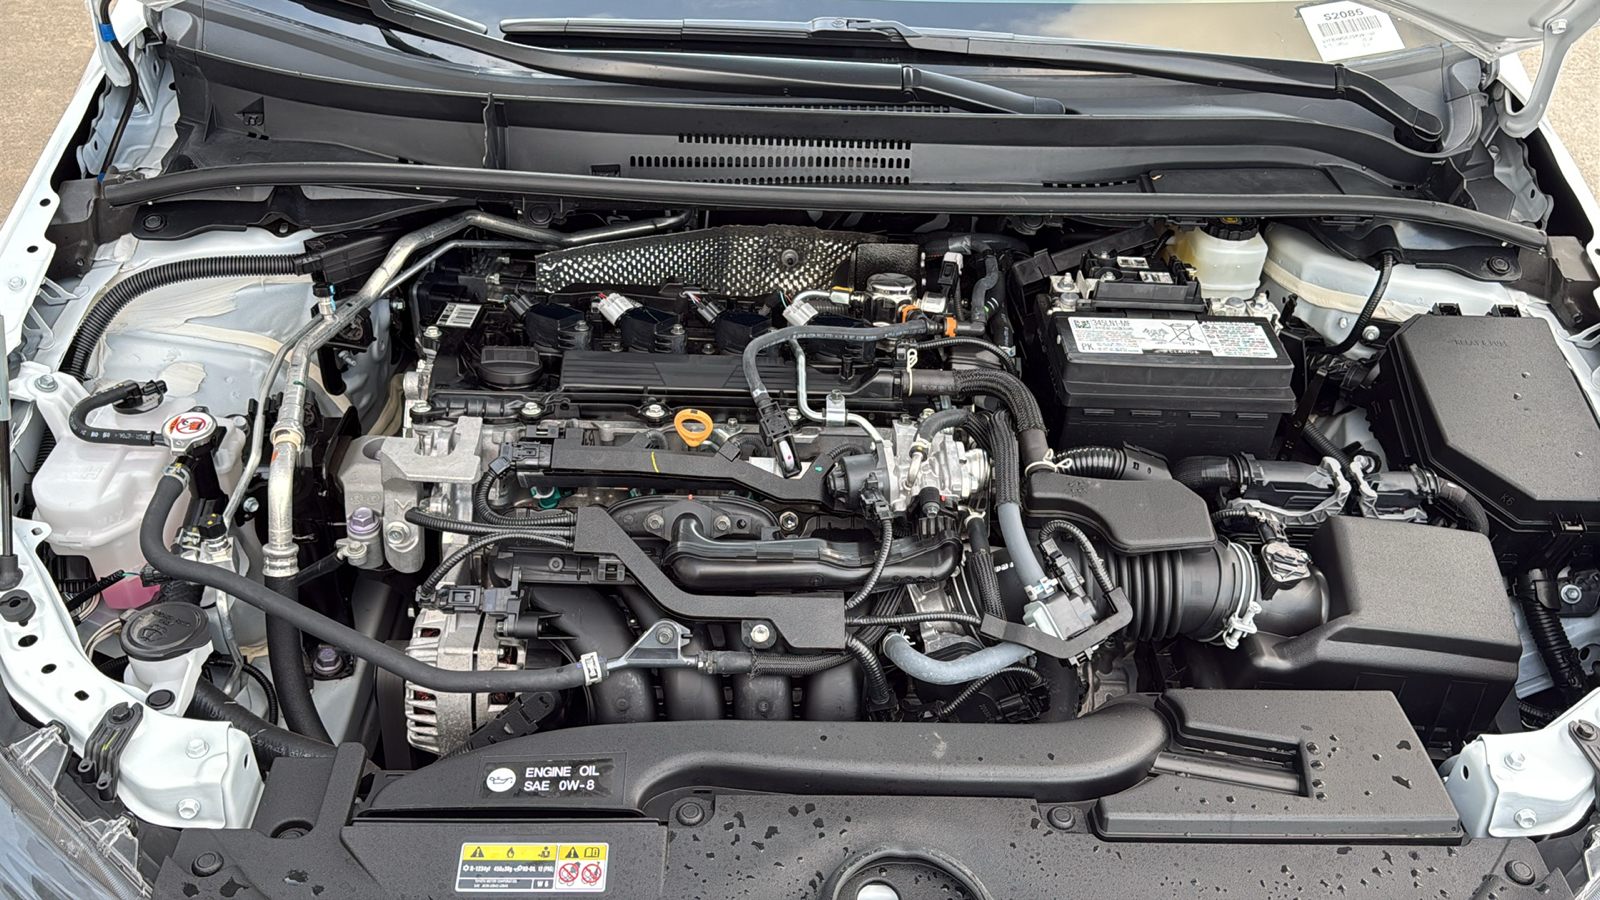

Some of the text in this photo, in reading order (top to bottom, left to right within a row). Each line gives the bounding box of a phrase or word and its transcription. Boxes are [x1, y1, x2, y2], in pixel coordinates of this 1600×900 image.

[1323, 8, 1364, 21] S2085
[1081, 342, 1094, 350] PK
[1500, 493, 1515, 506] K6
[525, 765, 600, 778] ENGINE OIL
[523, 780, 595, 791] SAE 0W-8
